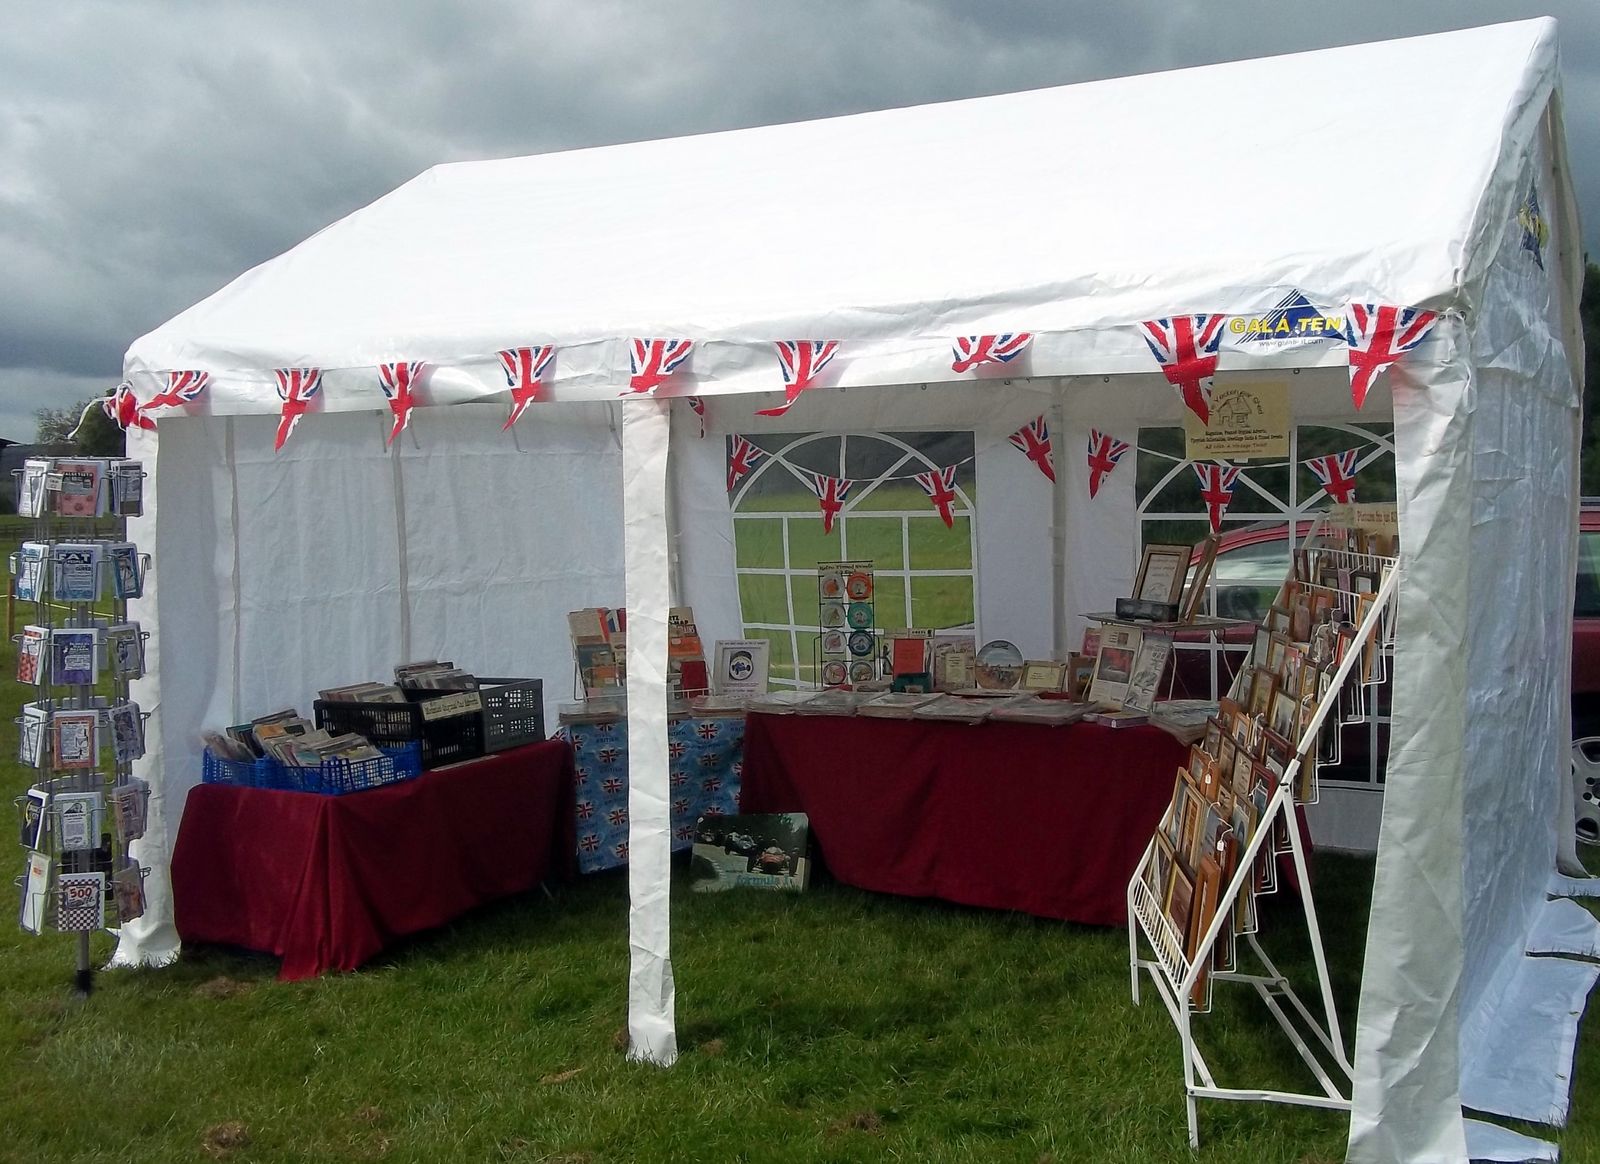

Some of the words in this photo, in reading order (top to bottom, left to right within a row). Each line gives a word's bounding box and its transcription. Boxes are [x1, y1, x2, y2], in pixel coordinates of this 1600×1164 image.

[1229, 316, 1290, 334] GALA
[1298, 317, 1342, 332] TEN
[69, 887, 92, 898] 500
